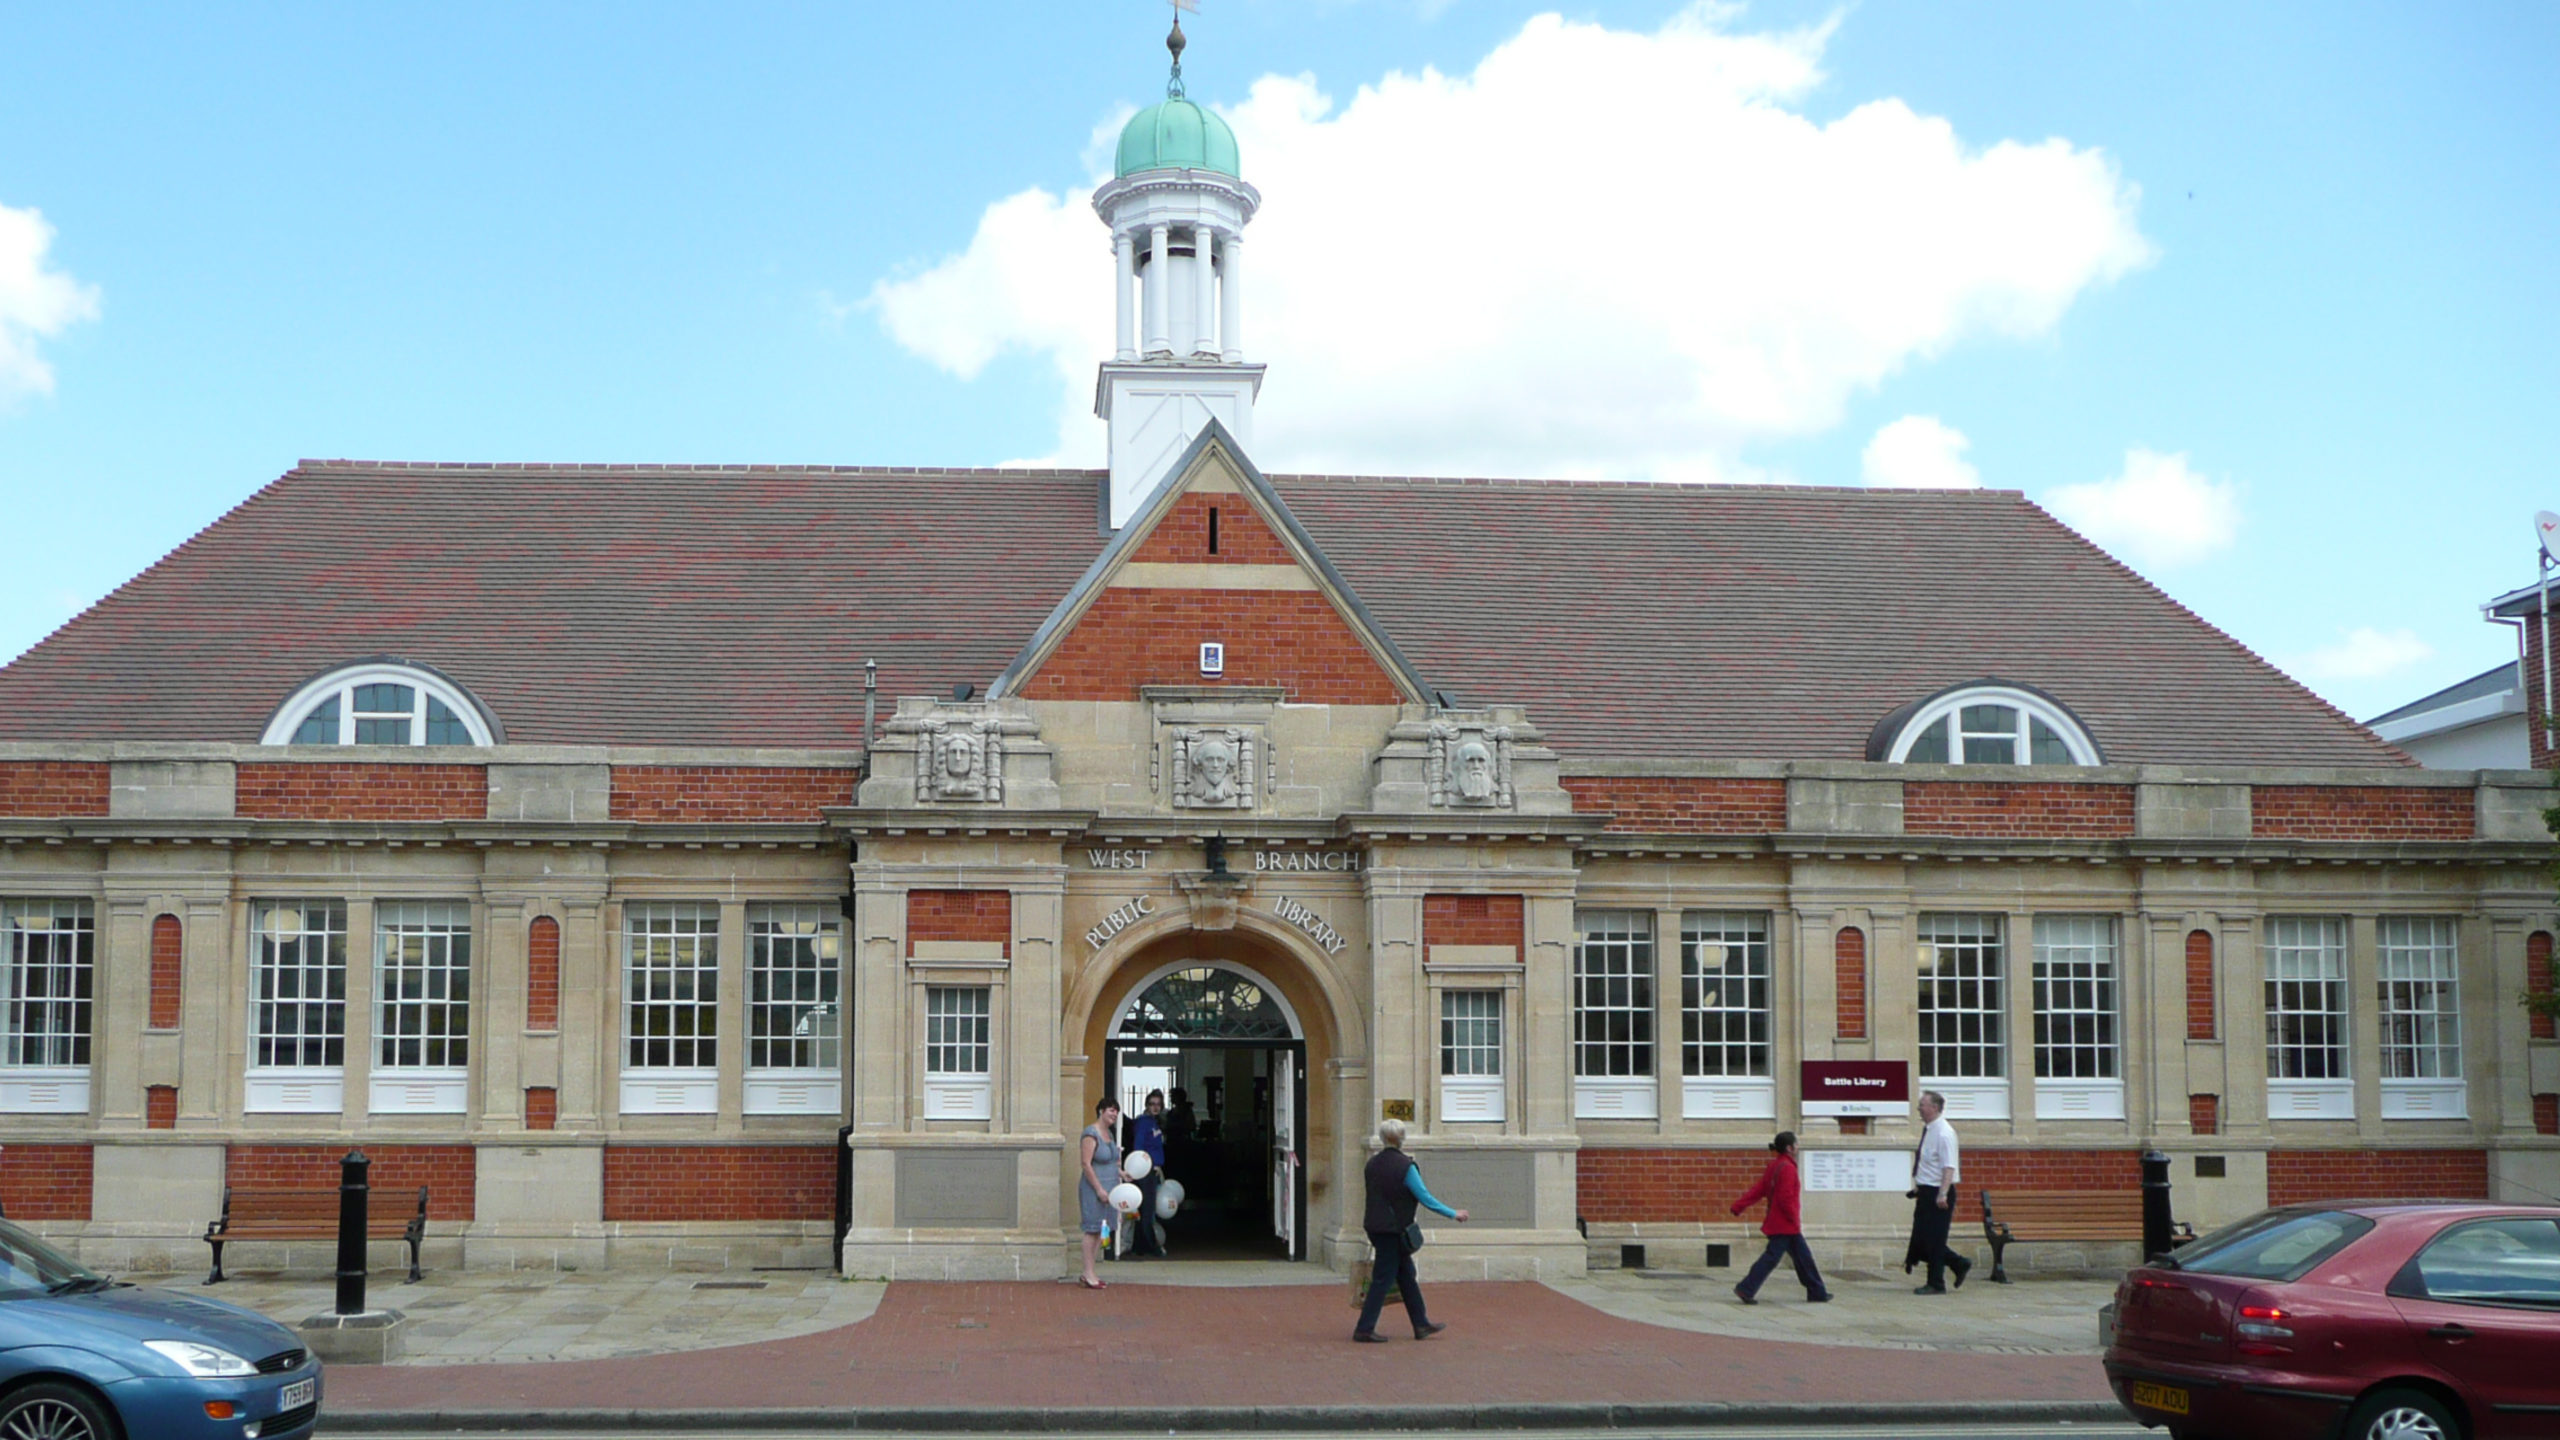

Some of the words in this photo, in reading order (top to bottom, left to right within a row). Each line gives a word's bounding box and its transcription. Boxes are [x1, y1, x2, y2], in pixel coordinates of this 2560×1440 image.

[1088, 849, 1152, 869] WEST
[1255, 851, 1360, 871] BRANCH
[1085, 894, 1156, 950] PUBLIC
[1273, 895, 1348, 955] LIBRARY
[1824, 1077, 1852, 1086] Battle
[1854, 1077, 1887, 1088] Library
